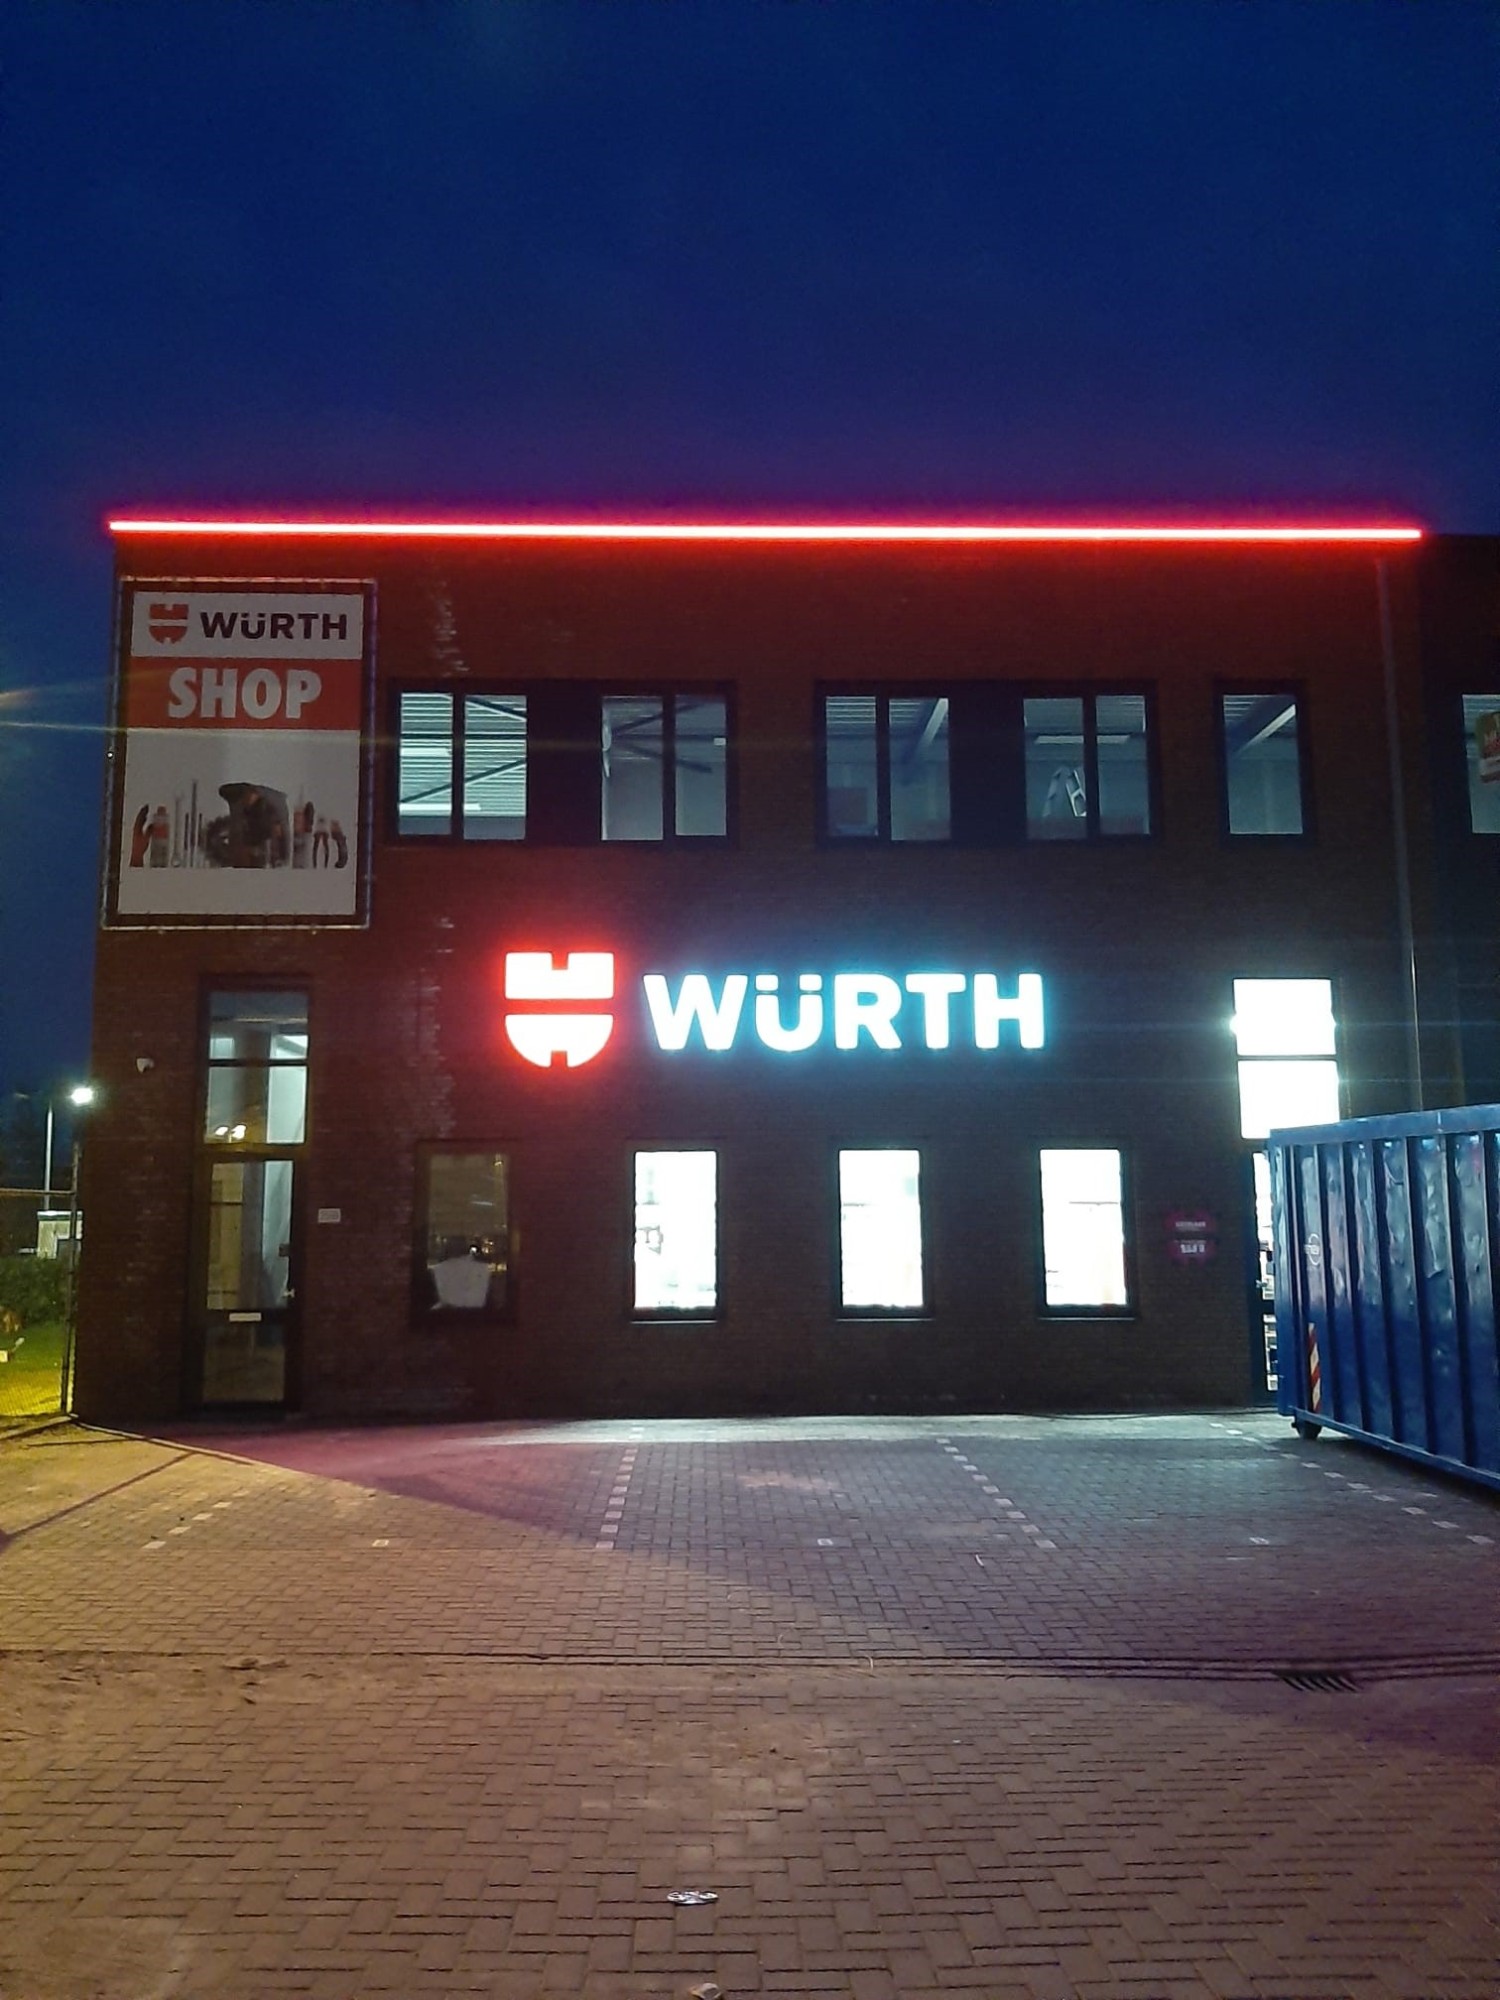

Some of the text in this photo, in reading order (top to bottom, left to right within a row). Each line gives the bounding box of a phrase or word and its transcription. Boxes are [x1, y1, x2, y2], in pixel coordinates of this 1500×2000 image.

[200, 611, 347, 640] WÜRTH
[168, 667, 322, 719] SHOP
[642, 972, 1044, 1052] WÜRTH
